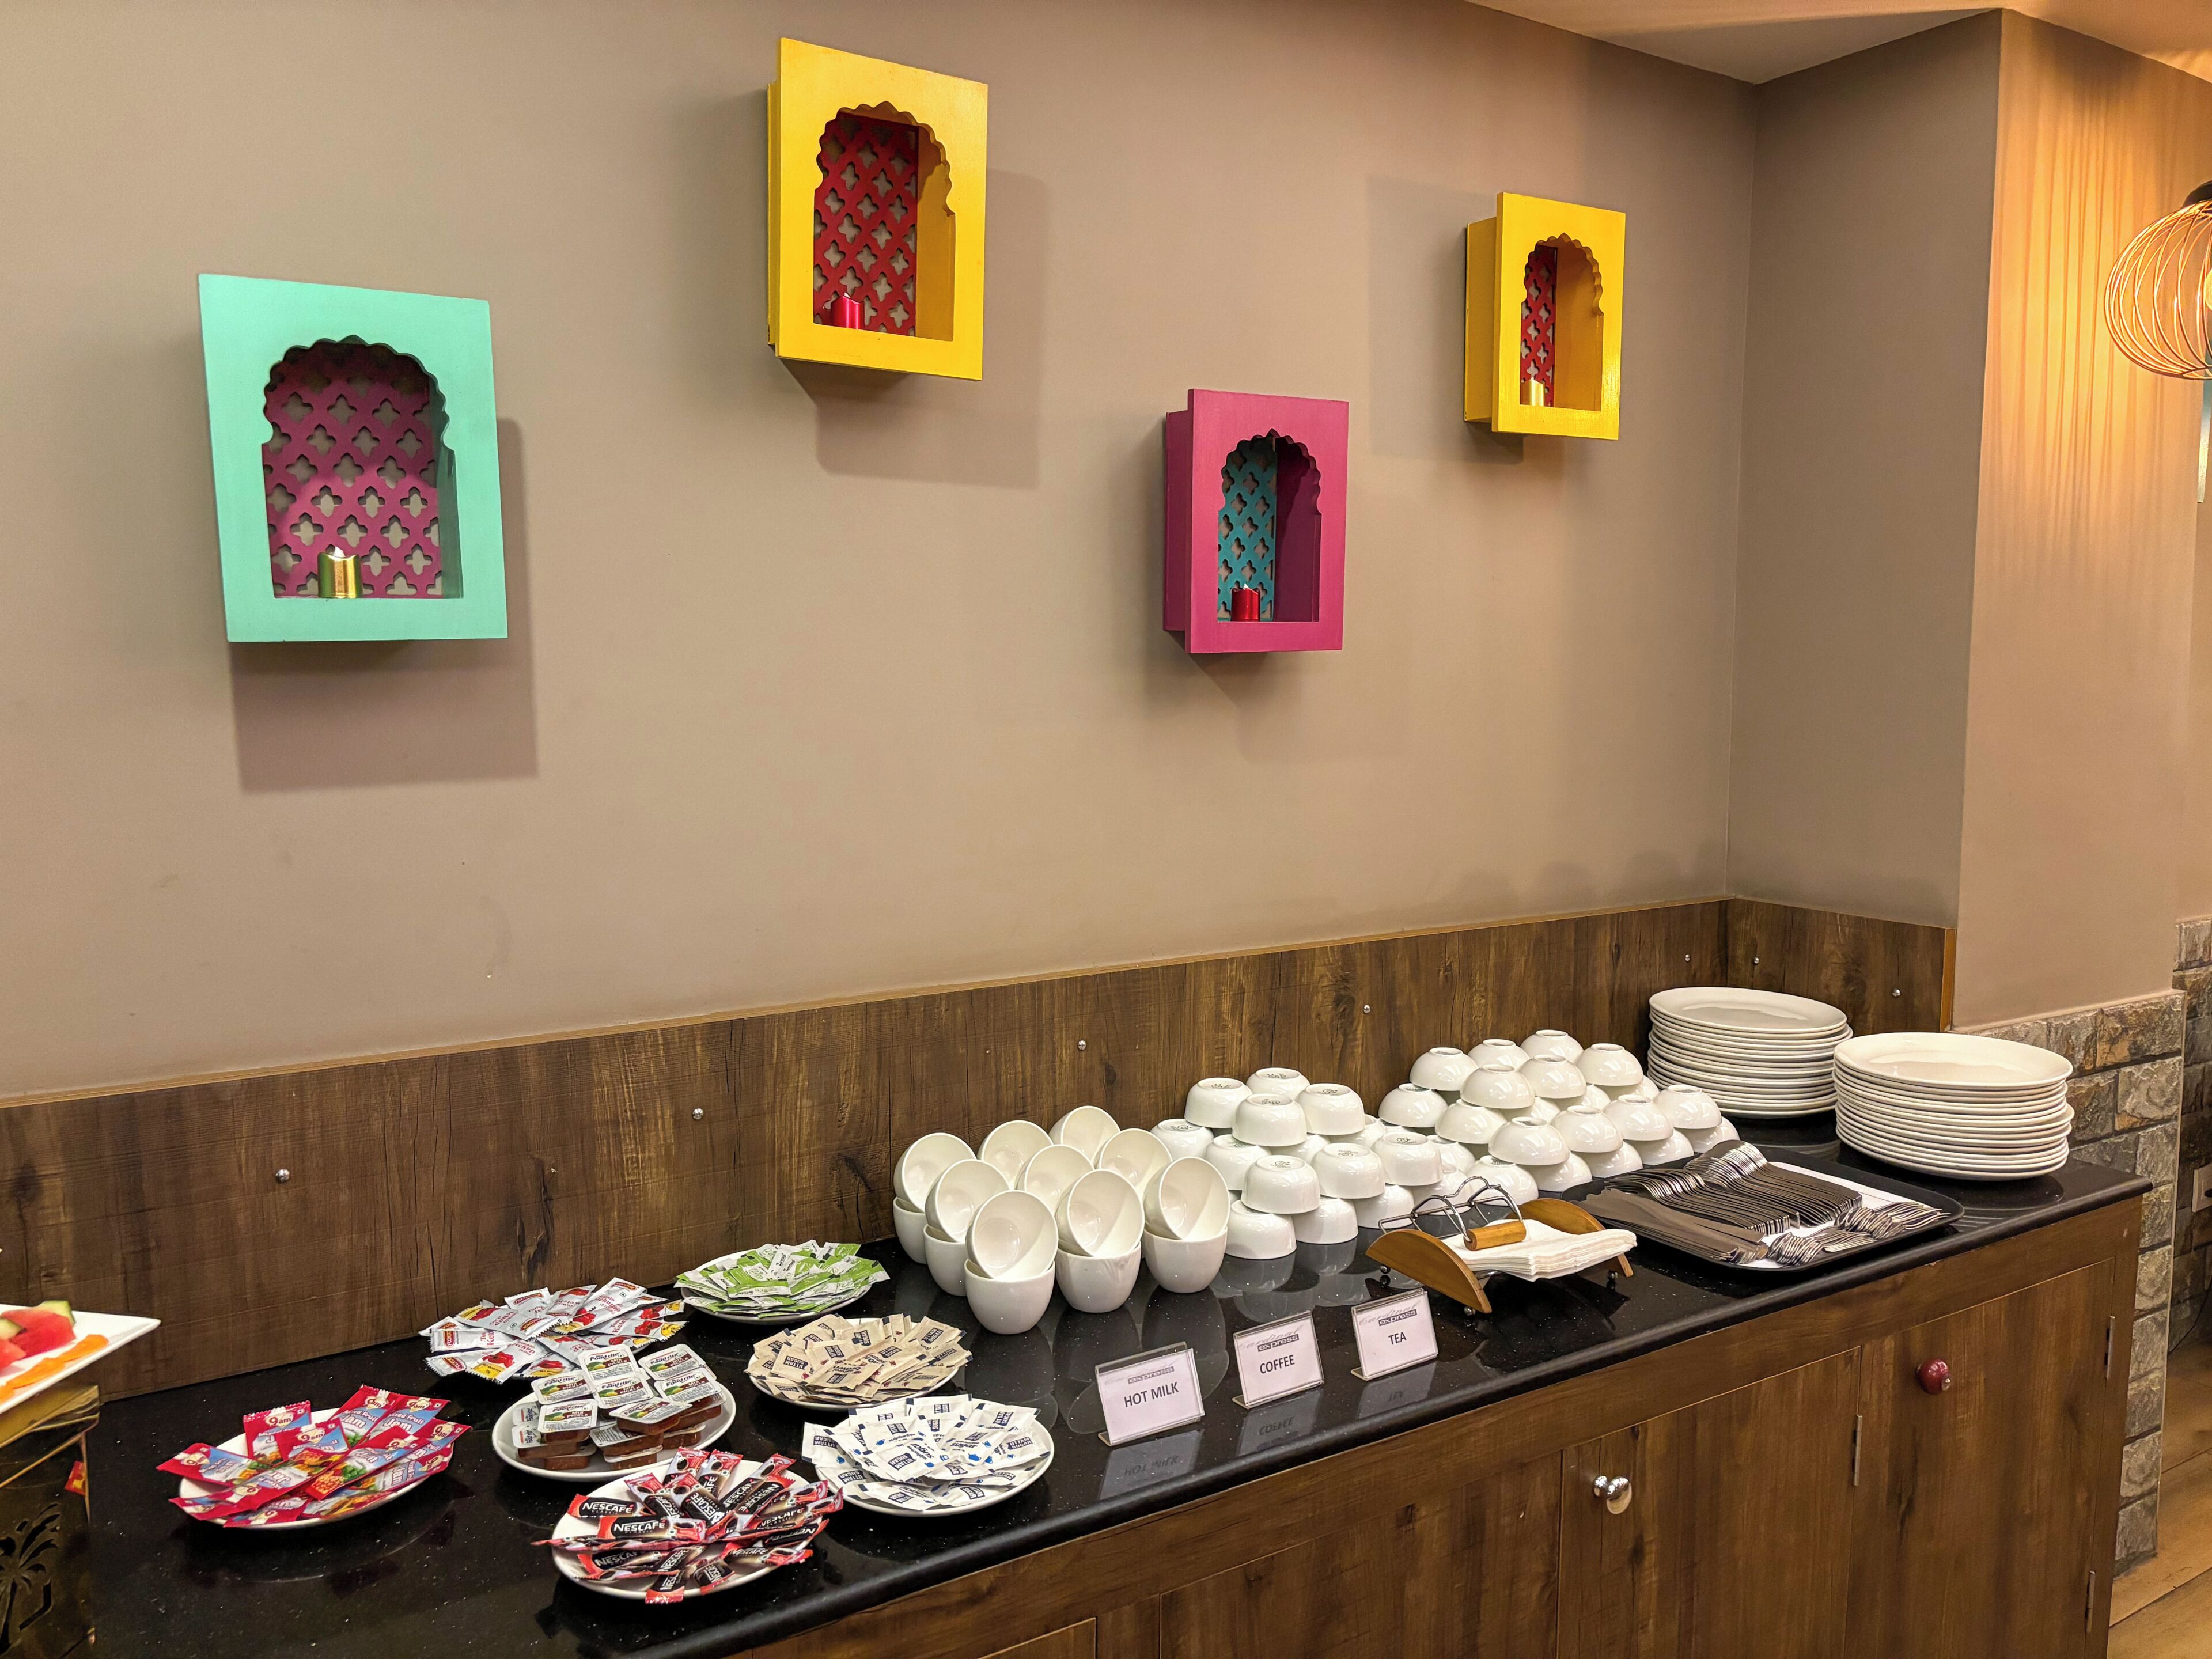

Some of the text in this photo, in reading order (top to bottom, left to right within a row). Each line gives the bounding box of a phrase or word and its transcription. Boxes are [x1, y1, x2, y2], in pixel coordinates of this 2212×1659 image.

[1378, 1309, 1417, 1326] express
[861, 1330, 870, 1344] SUGAR
[929, 1330, 942, 1343] SUGAR
[1257, 1334, 1300, 1352] express
[1388, 1332, 1407, 1345] TEA
[785, 1361, 804, 1369] UTTAM
[786, 1356, 805, 1365] SUGAR
[1260, 1354, 1295, 1374] COFFEE
[1128, 1366, 1175, 1384] express
[1124, 1381, 1179, 1407] HOT MILK
[268, 1416, 292, 1426] 9am
[341, 1415, 367, 1429] Jam
[407, 1414, 425, 1425] Fruit
[301, 1433, 325, 1441] 9am
[432, 1425, 448, 1438] 9am
[1010, 1437, 1029, 1446] UTTAM
[910, 1442, 934, 1459] sugar
[889, 1453, 909, 1465] SUGAR
[894, 1457, 914, 1471] UTTAM
[391, 1467, 404, 1486] Jam
[839, 1470, 861, 1479] SUGAR
[842, 1474, 863, 1484] UTTAM
[582, 1501, 634, 1514] NESCAFÉ
[613, 1520, 666, 1532] NESCAFÉ
